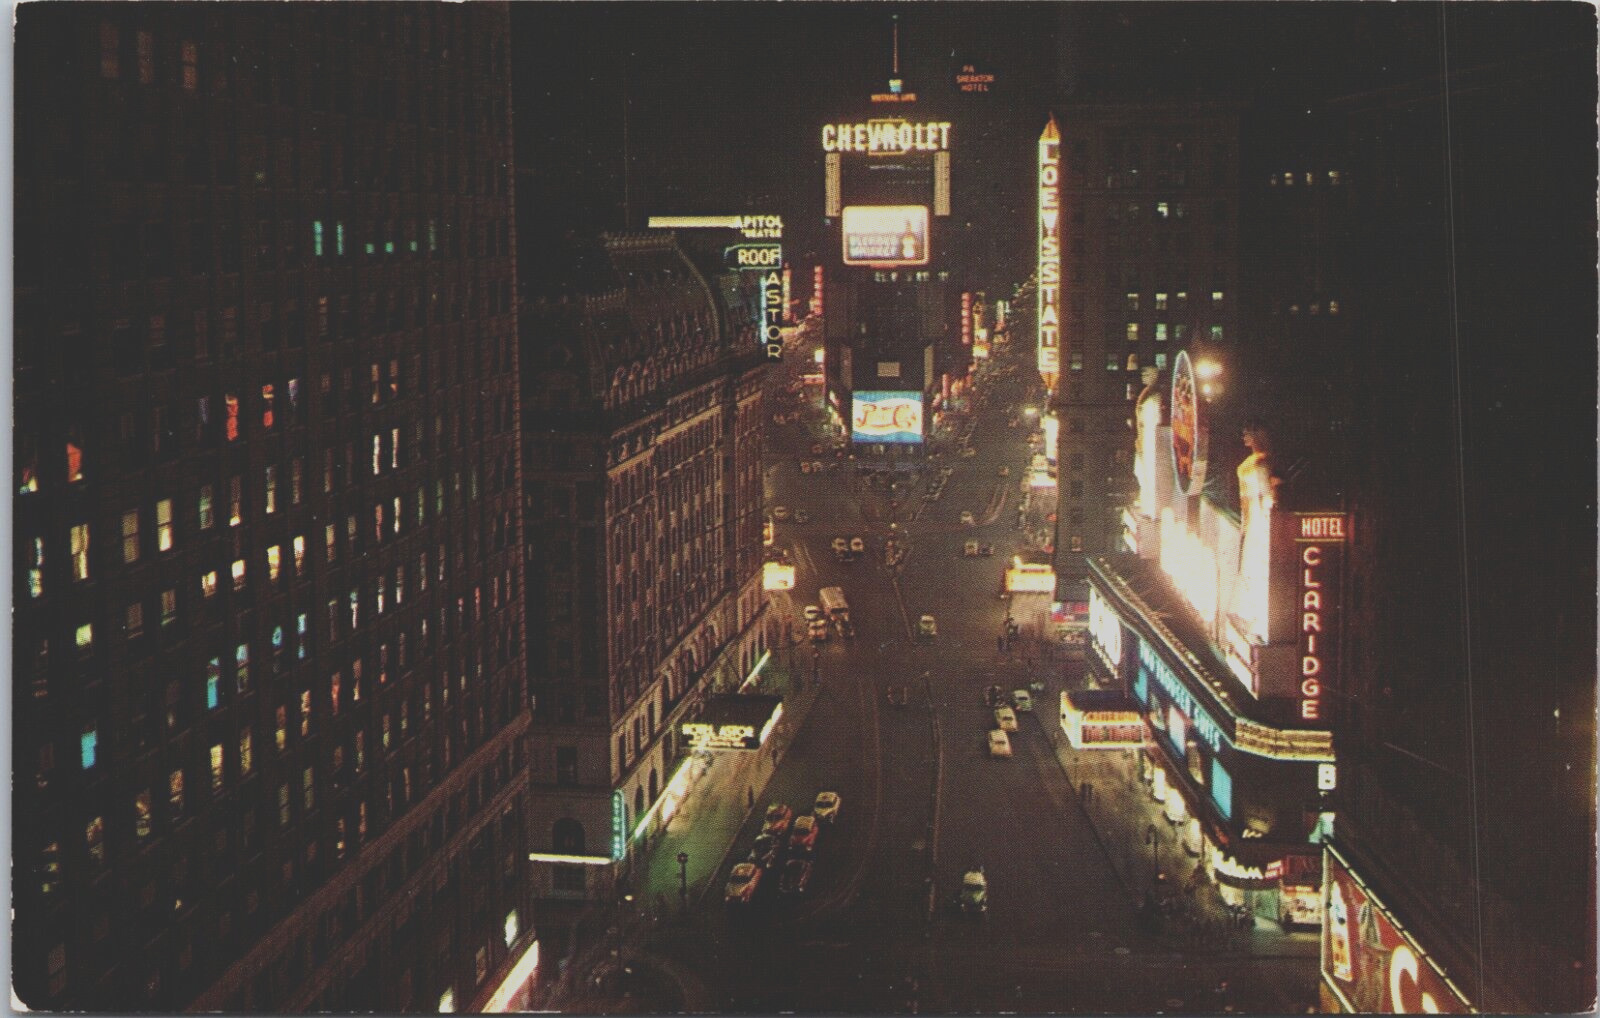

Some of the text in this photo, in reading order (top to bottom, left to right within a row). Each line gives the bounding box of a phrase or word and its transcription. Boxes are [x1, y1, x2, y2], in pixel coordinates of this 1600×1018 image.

[822, 122, 951, 152] CHEVROLET
[735, 215, 784, 229] APITOL
[738, 248, 780, 265] ROOF
[766, 272, 781, 358] ASTOR
[1041, 262, 1059, 368] STATE
[1302, 517, 1344, 537] HOTEL
[1302, 547, 1321, 719] CLARIDGE
